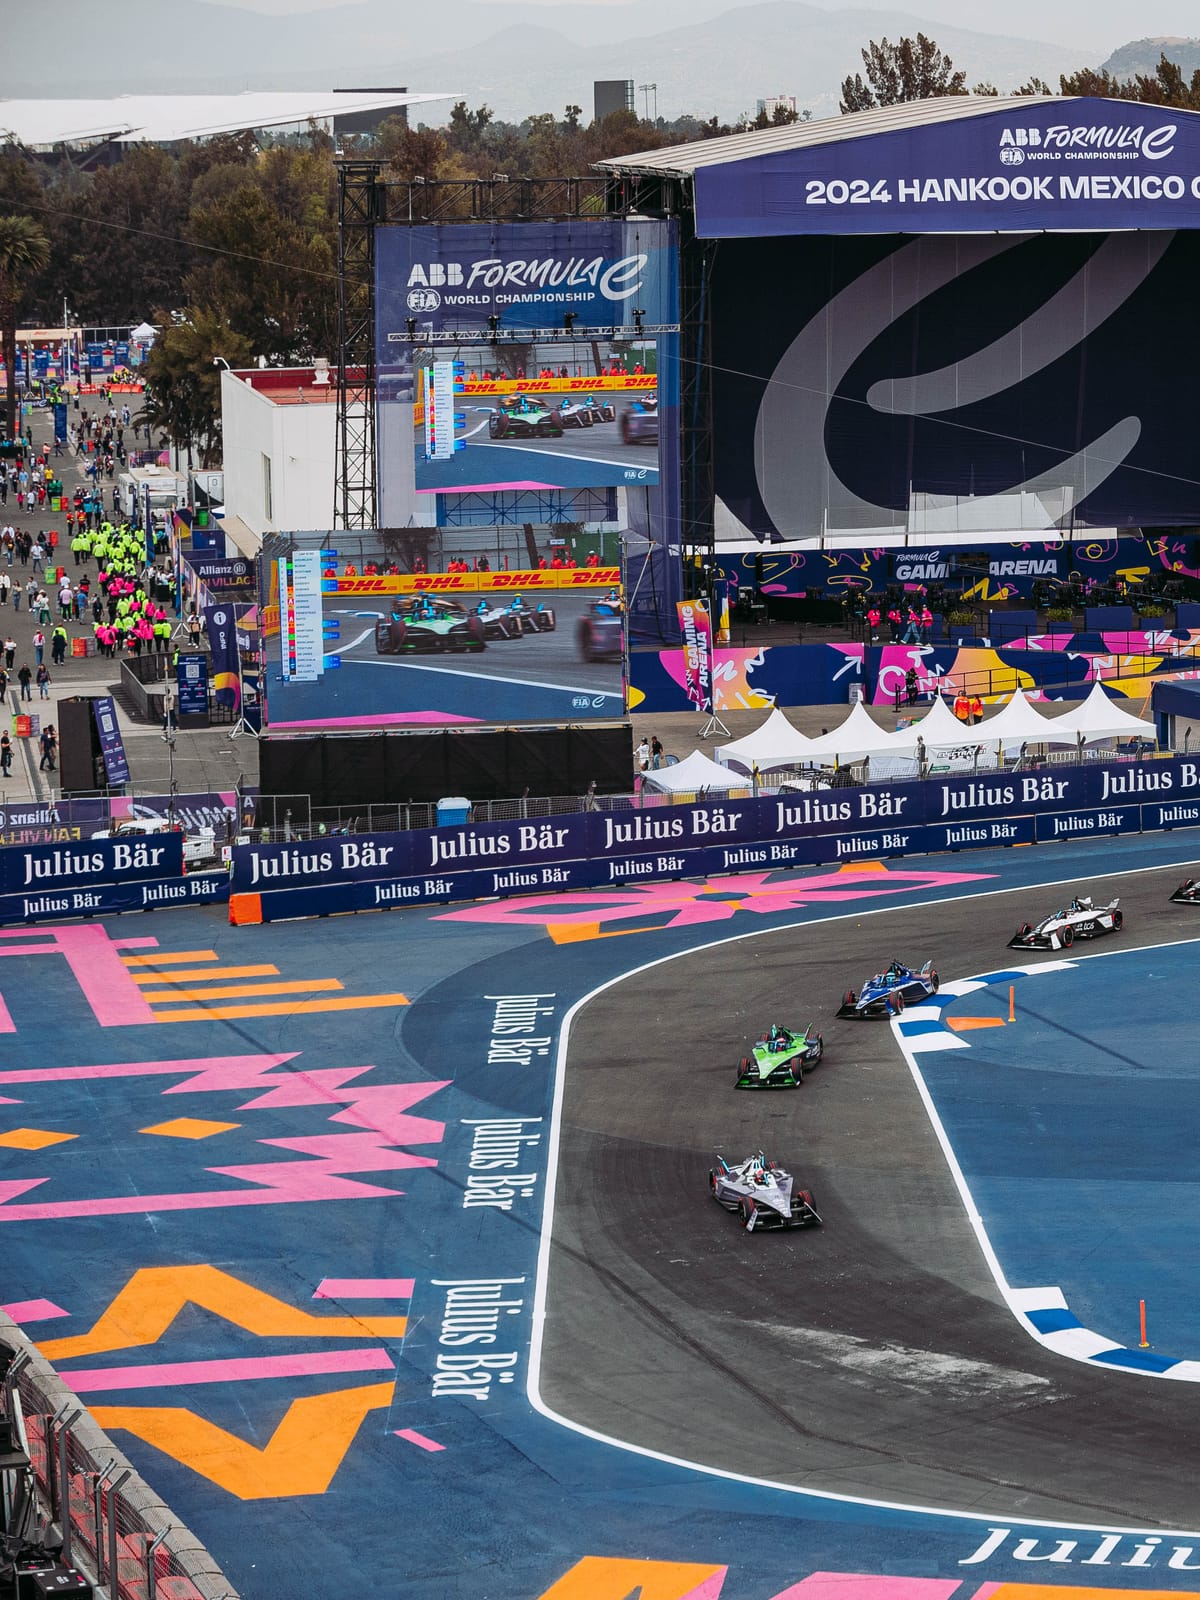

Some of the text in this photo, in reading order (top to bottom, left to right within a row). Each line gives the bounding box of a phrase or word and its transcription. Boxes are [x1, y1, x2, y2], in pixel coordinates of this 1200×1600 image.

[1000, 128, 1041, 146] ABB
[1043, 125, 1143, 147] FORMULA
[1027, 152, 1062, 160] WORLD
[1065, 151, 1140, 160] CHAMPIONSHIP
[805, 180, 892, 205] 2024
[898, 177, 1055, 203] HANKOOK
[1059, 176, 1186, 200] MEXICO
[407, 263, 464, 287] ABB
[466, 256, 604, 289] FORMULA
[408, 290, 596, 311] FIA WORLD CHAMPIONSHIP
[516, 379, 605, 390] DHL DHL
[200, 566, 232, 575] Allianz
[897, 559, 1058, 580] GAMI ARENA
[337, 573, 544, 592] DHL DHL DHL
[681, 604, 700, 671] GAMING
[694, 631, 708, 688] ARENA
[942, 777, 1069, 815] Julius Bär
[1102, 769, 1172, 800] Julius
[777, 793, 907, 832] Julius Bär
[1055, 814, 1123, 834] Julius Bär
[1160, 807, 1198, 824] Julius
[605, 809, 741, 848] Julius Bär
[947, 824, 1017, 845] Julius Bär
[430, 825, 569, 866] Julius Bär
[724, 845, 798, 867] Julius Bär
[24, 843, 164, 884] Julius Bär
[250, 842, 393, 884] Julius Bär
[610, 857, 685, 879] Julius Bär
[494, 868, 570, 891] Julius Bär
[143, 880, 218, 904] Julius Bär
[376, 880, 453, 903] Julius Bär
[24, 893, 102, 916] Julius Bär
[484, 993, 556, 1065] Julius Bär
[460, 1117, 543, 1212] Julius Bär
[431, 1276, 525, 1400] Julius Bär
